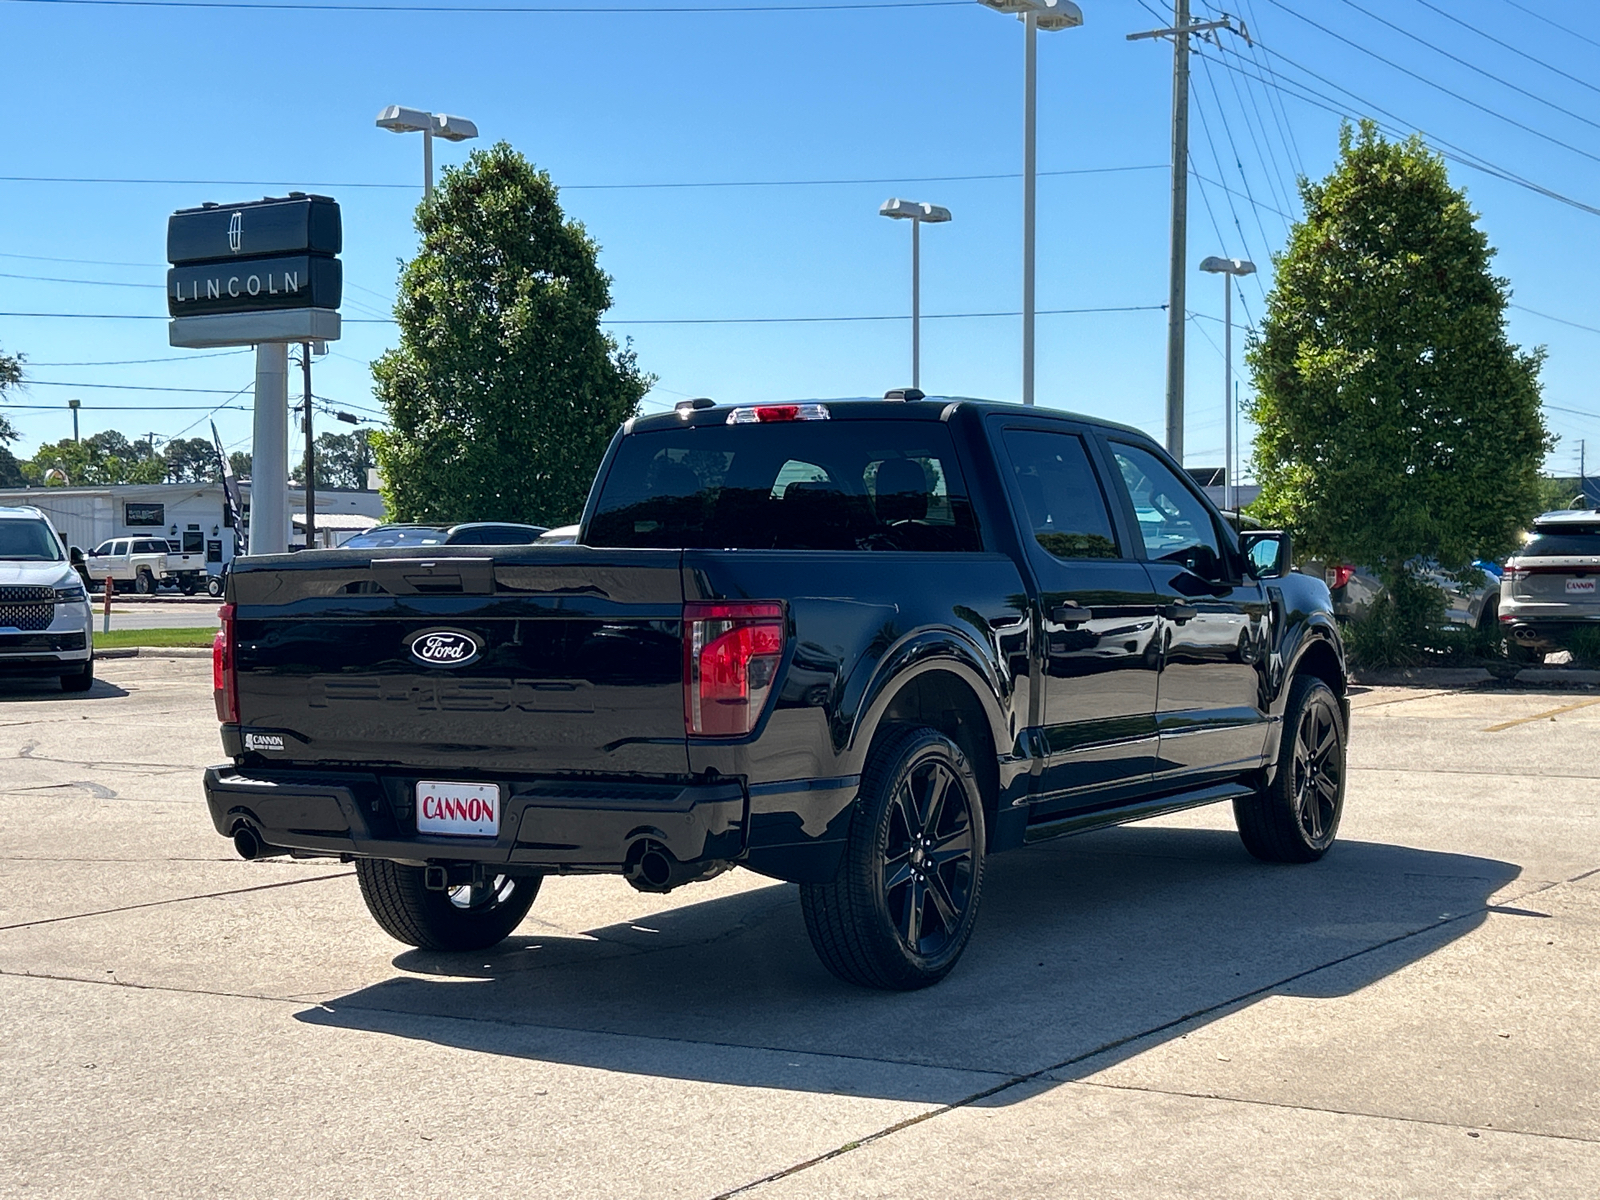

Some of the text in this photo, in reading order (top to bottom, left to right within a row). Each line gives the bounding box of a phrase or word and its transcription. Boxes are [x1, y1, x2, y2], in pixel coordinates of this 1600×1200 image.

[176, 271, 299, 302] LINCOLN
[1566, 581, 1595, 590] CANNON
[422, 636, 465, 658] Ford
[308, 677, 595, 713] F-150
[253, 735, 284, 746] CANNON
[422, 796, 494, 823] CANNON
